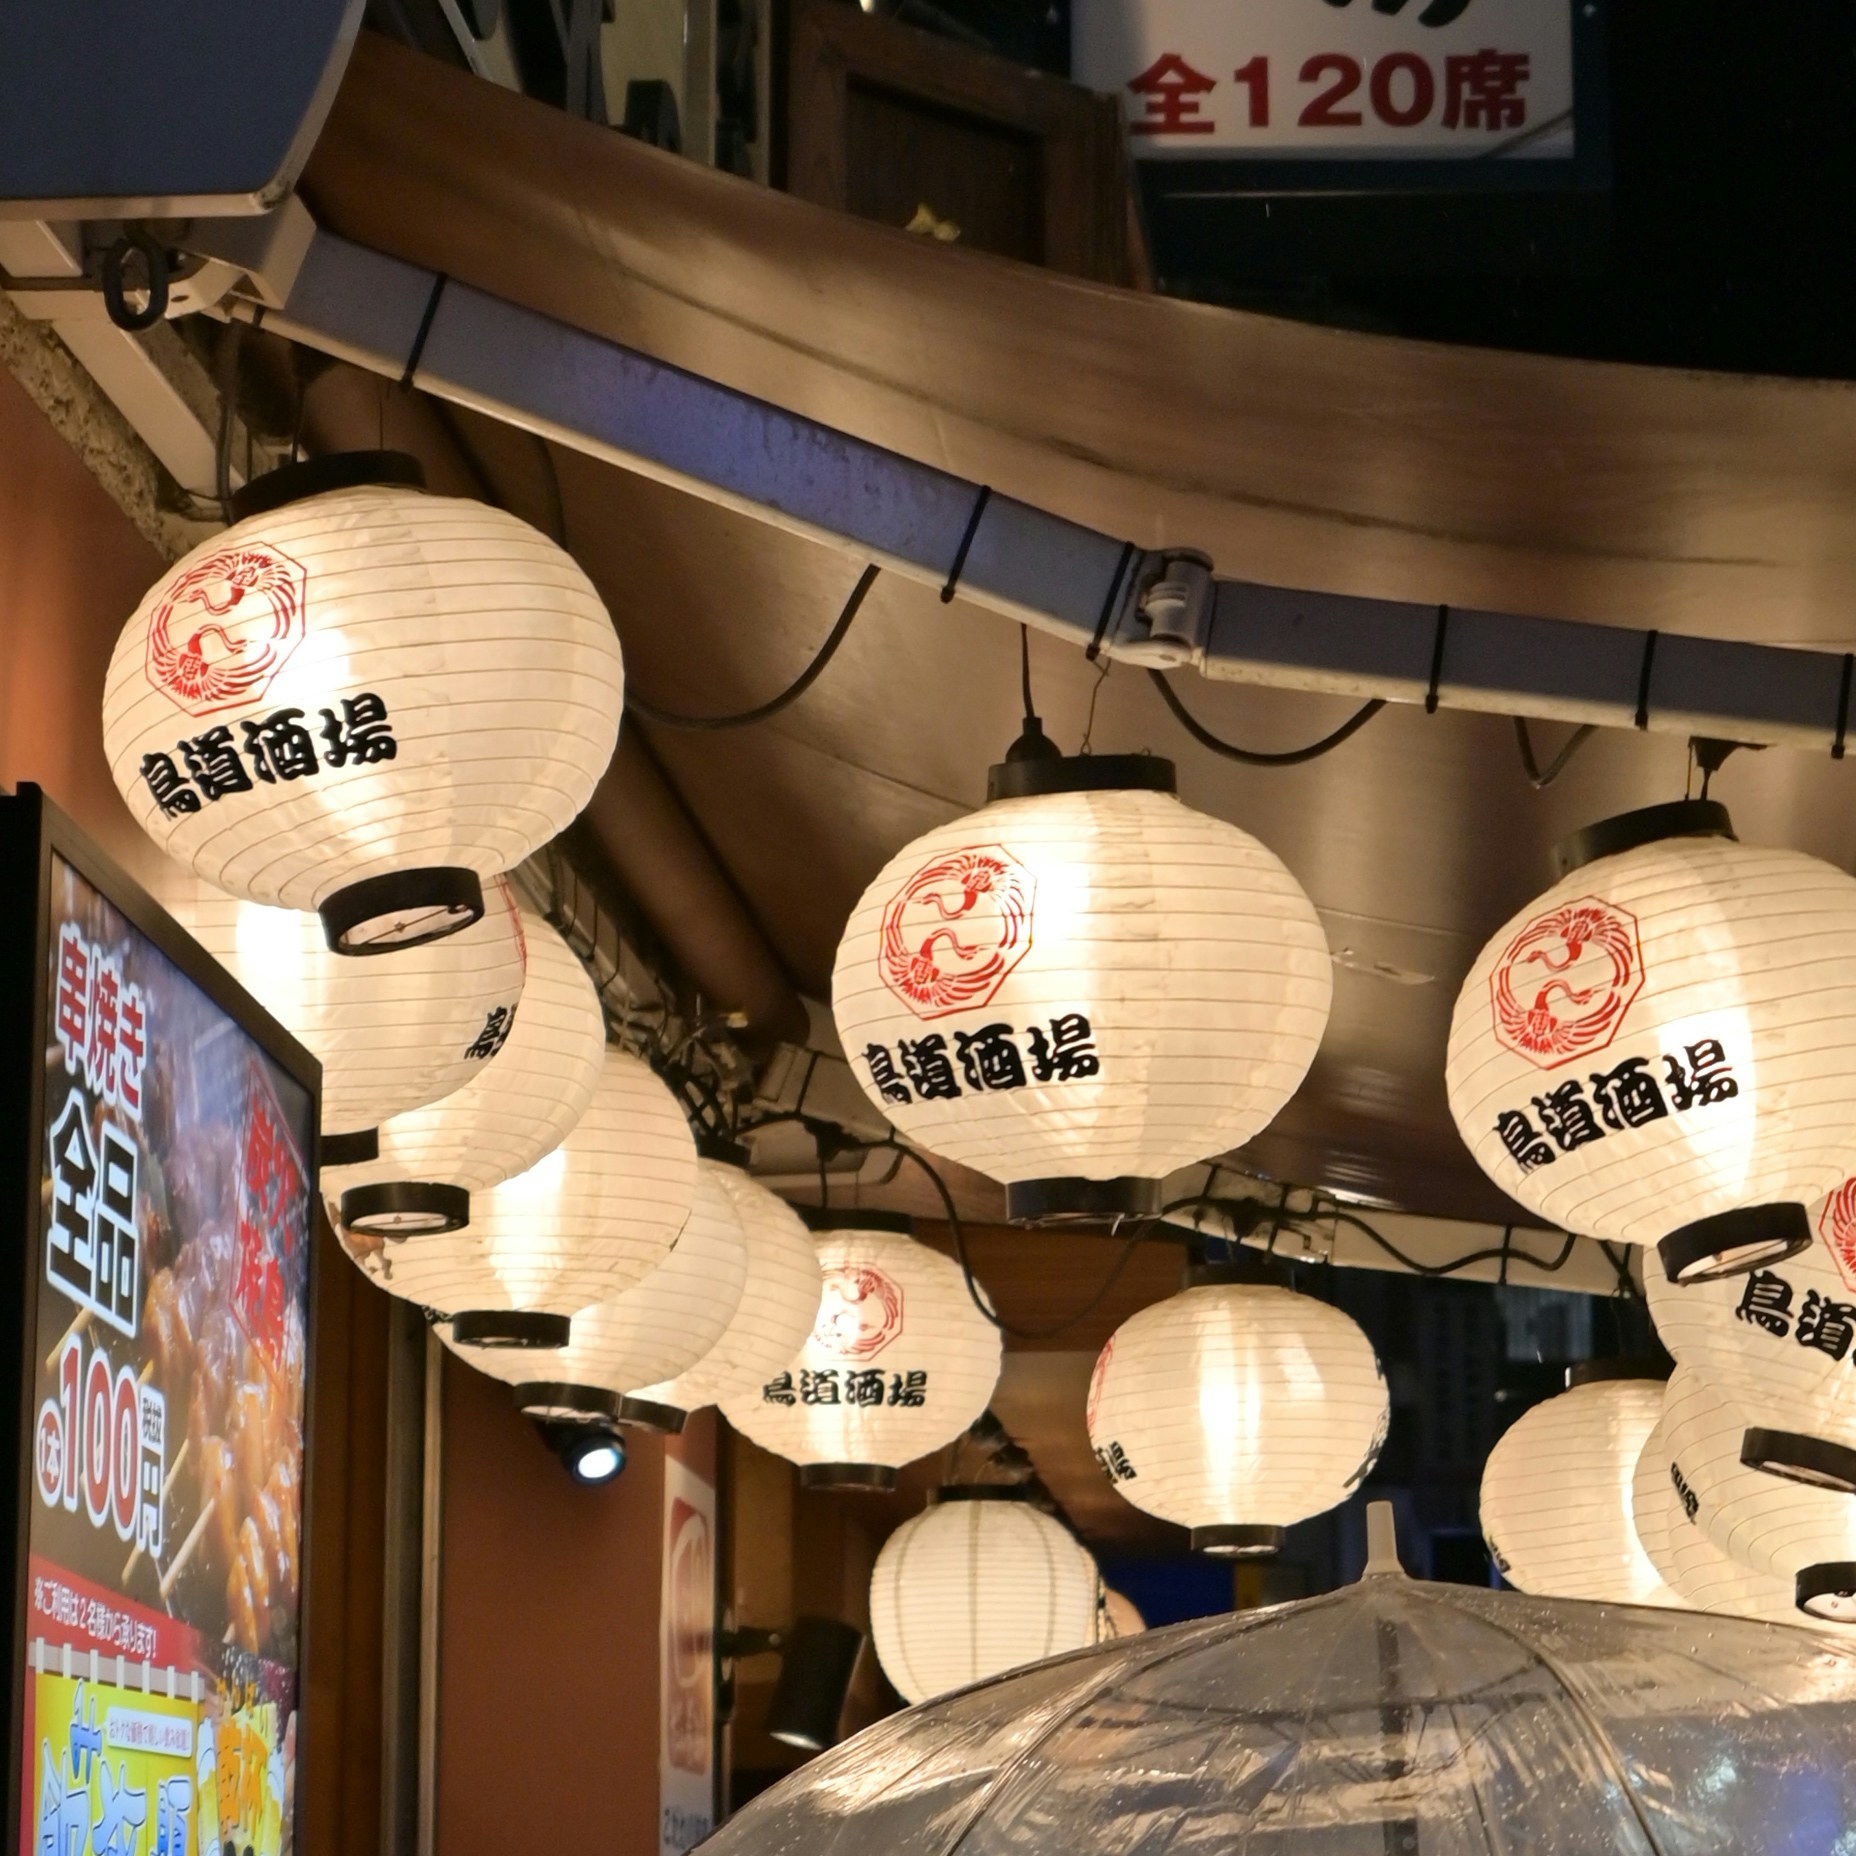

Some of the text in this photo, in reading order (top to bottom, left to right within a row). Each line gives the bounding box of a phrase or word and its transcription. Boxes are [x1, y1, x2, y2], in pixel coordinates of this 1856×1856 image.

[1129, 47, 1532, 136] 全120席
[139, 692, 399, 821] 鳥道酒場
[56, 923, 146, 1121] 串焼き
[862, 1013, 1100, 1105] 鳥道酒場
[1493, 1038, 1740, 1175] 鳥道酒場
[48, 1088, 138, 1339] 全品
[762, 1368, 927, 1408] 鳥道酒場
